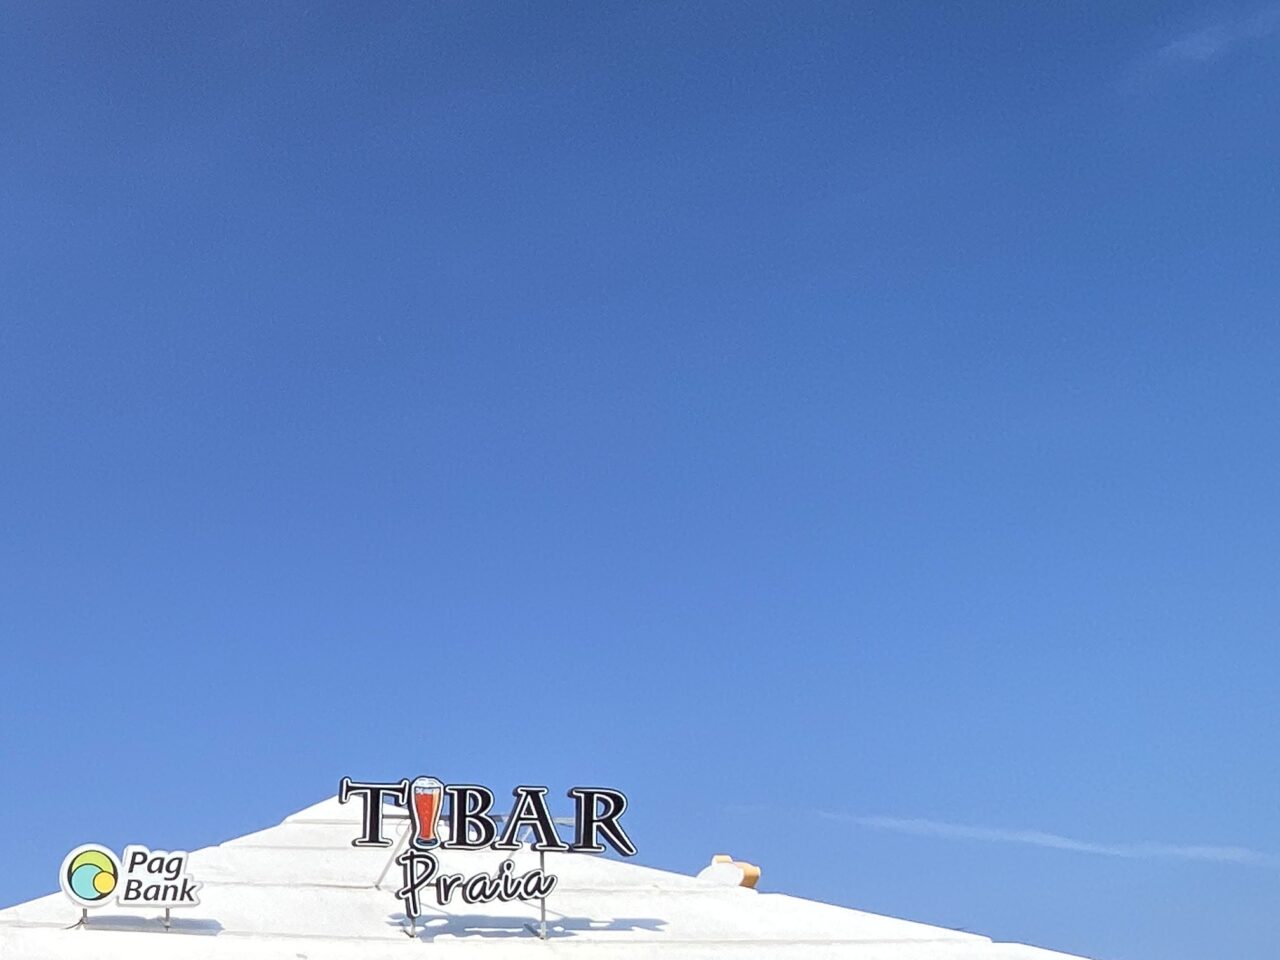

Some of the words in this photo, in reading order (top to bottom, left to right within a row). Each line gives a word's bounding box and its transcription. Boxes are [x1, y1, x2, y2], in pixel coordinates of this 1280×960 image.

[128, 851, 184, 881] Pag
[123, 878, 197, 902] Bank
[395, 849, 558, 918] Praia
